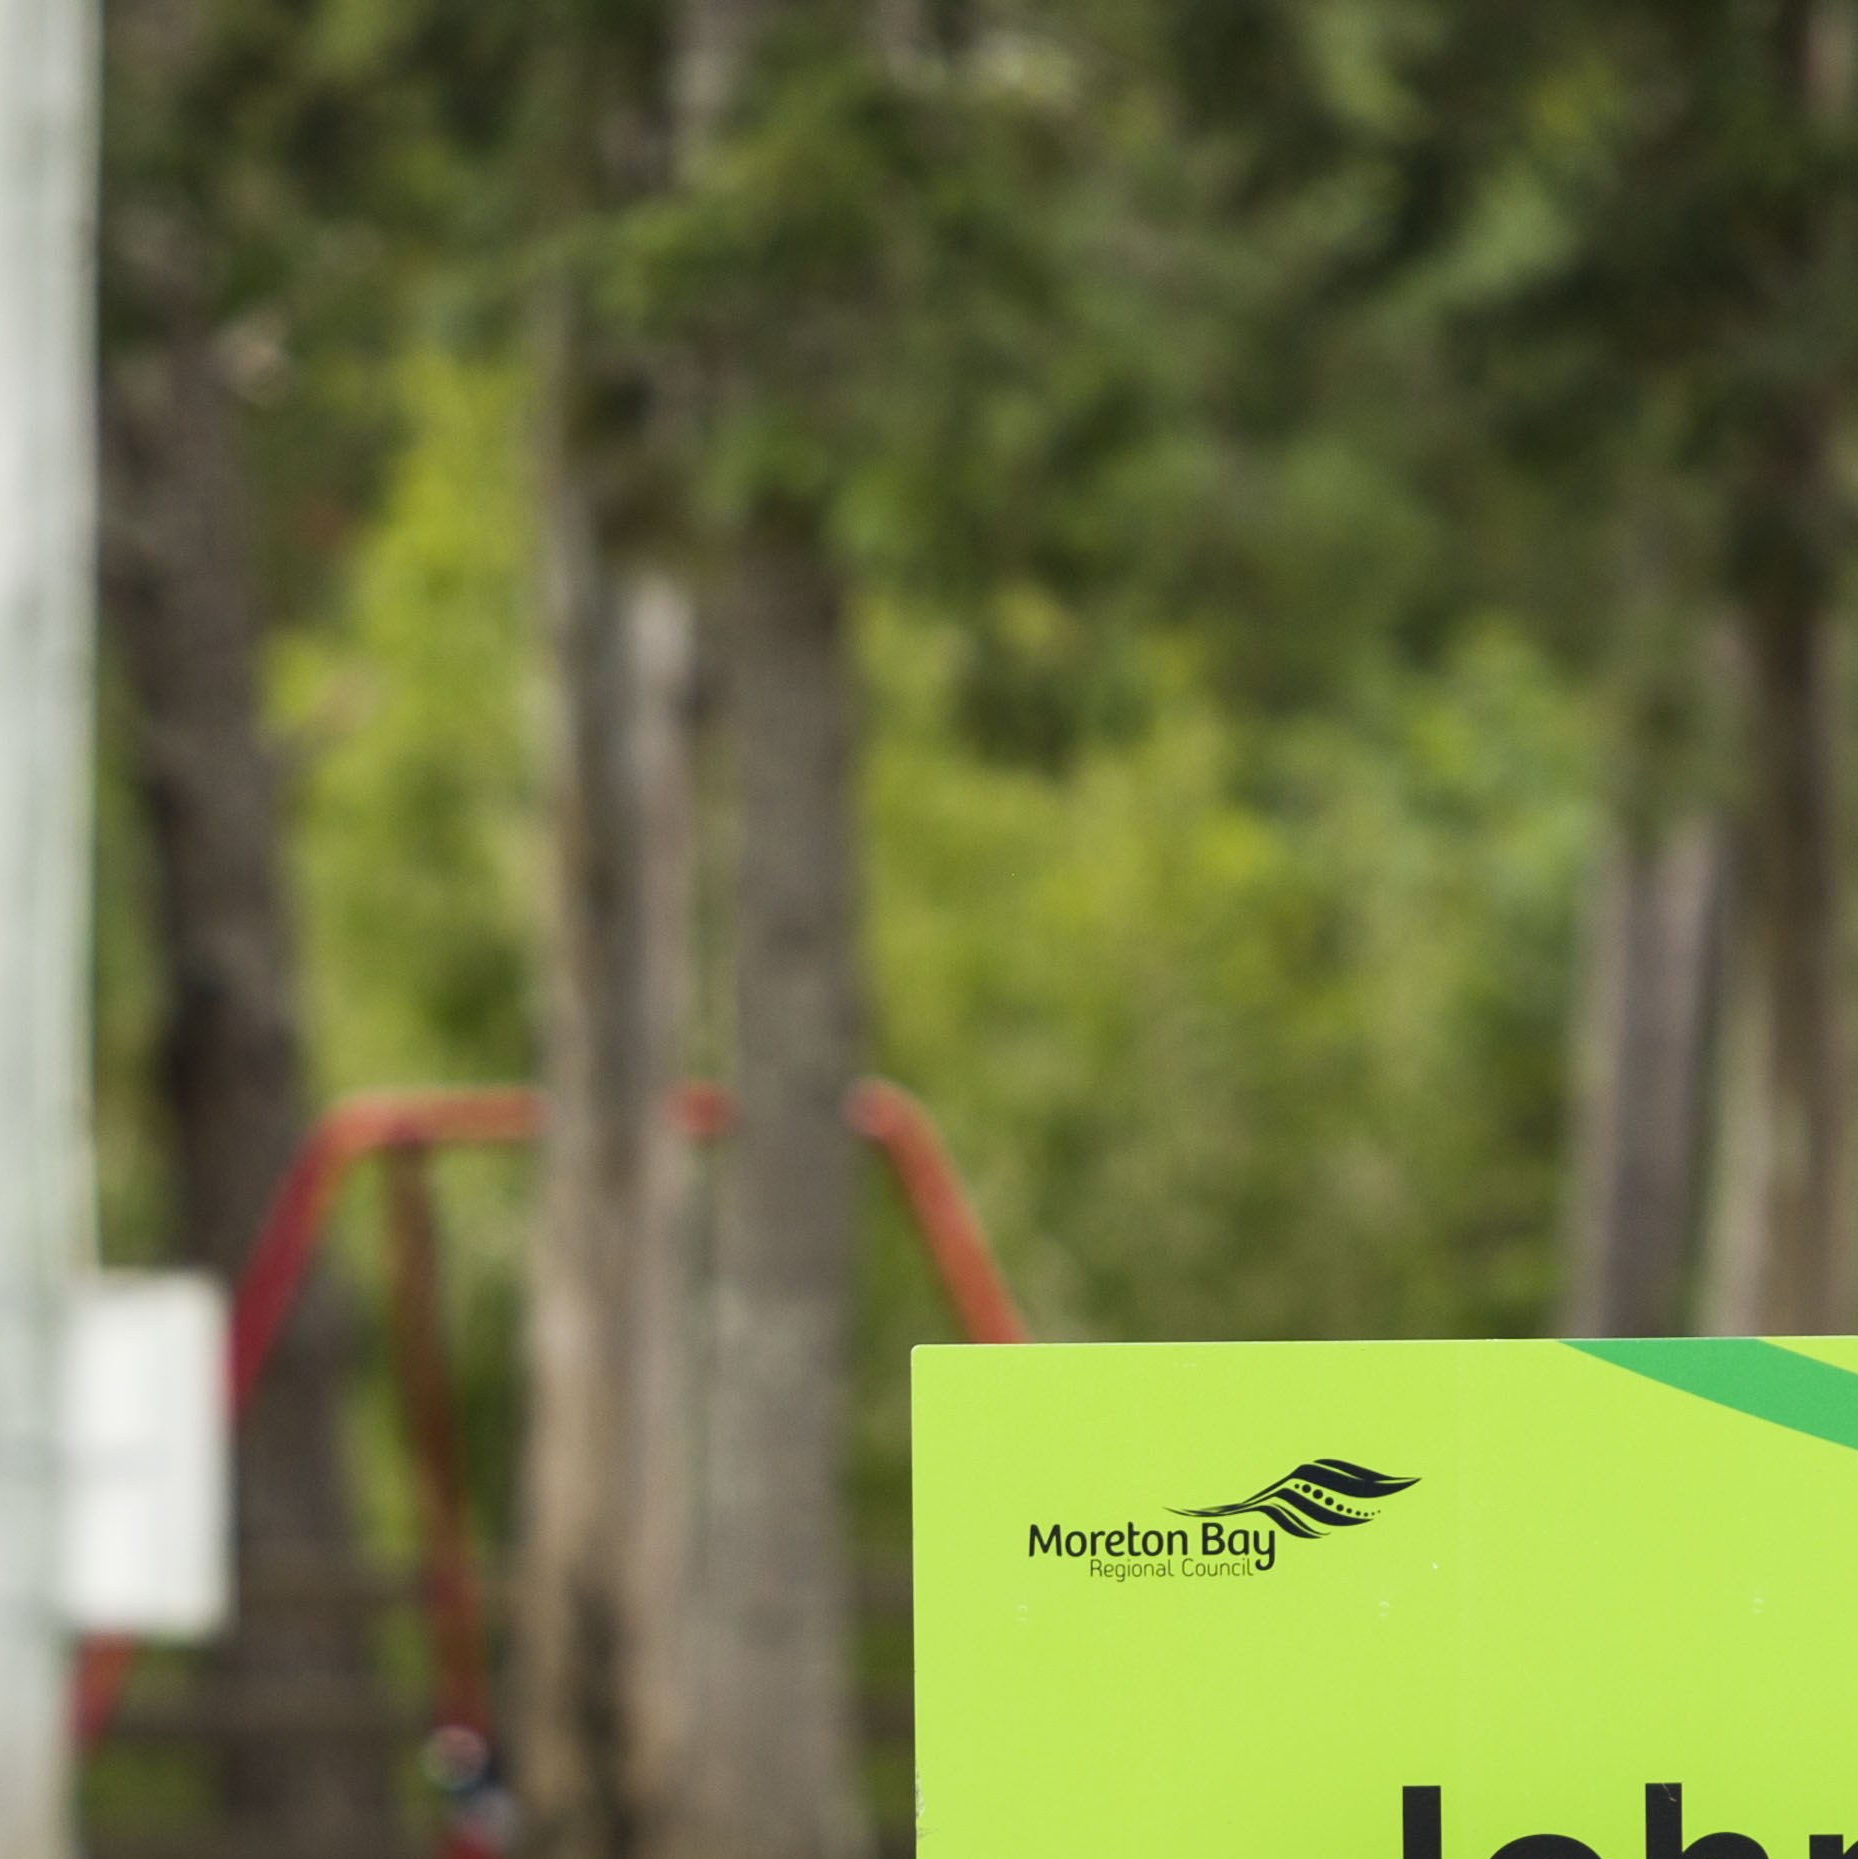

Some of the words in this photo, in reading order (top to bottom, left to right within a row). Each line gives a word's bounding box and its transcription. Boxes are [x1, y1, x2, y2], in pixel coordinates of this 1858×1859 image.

[1028, 1521, 1188, 1558] Moreton
[1201, 1522, 1276, 1571] Bay
[1089, 1559, 1174, 1583] Regional
[1181, 1558, 1254, 1577] Council
